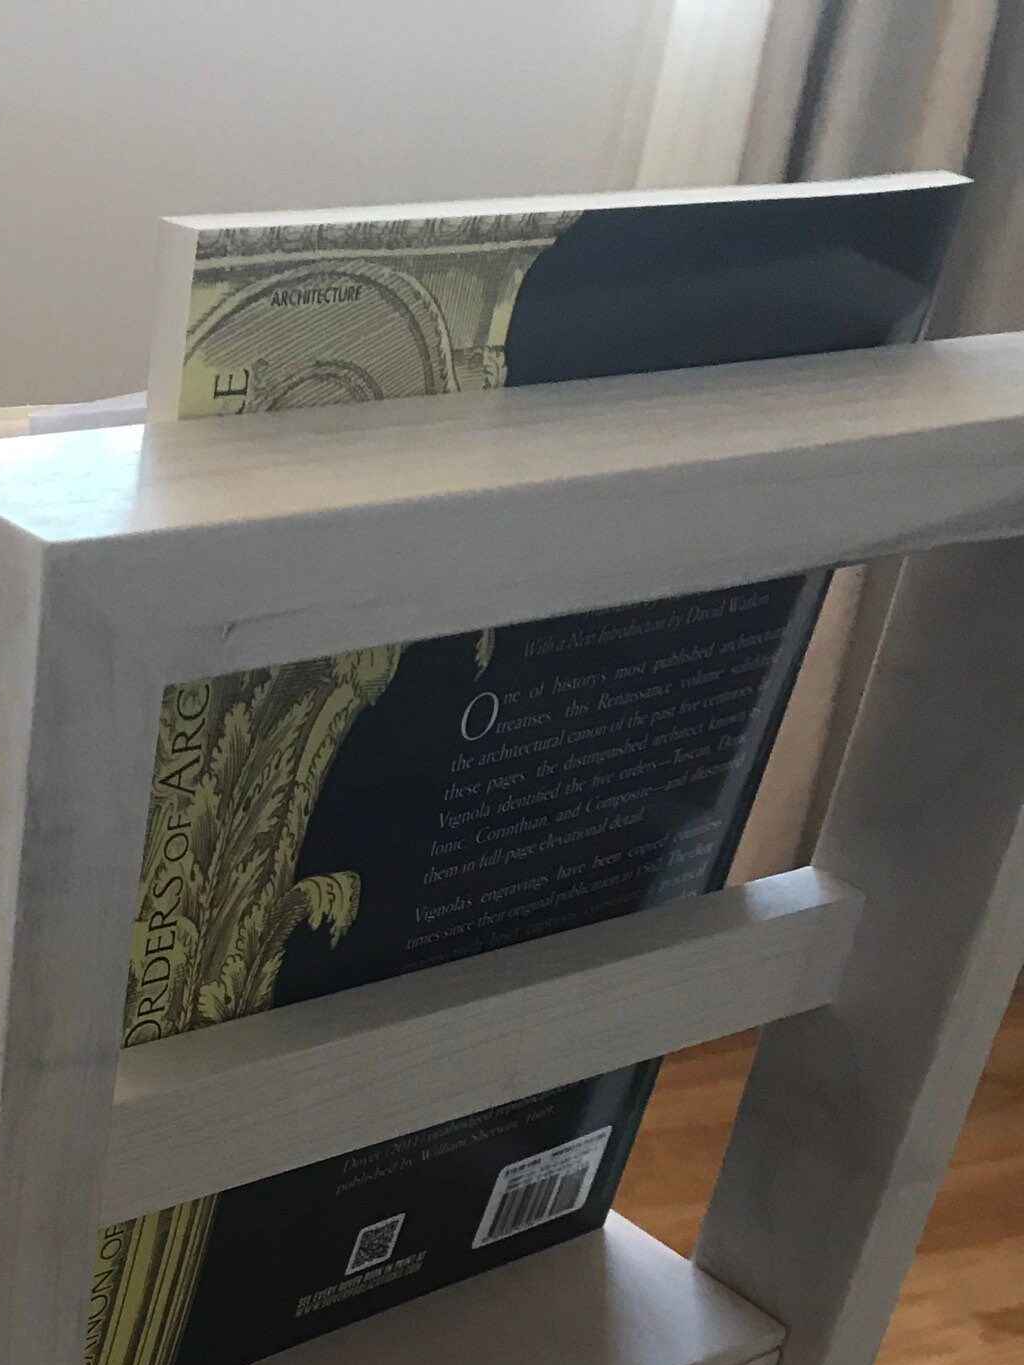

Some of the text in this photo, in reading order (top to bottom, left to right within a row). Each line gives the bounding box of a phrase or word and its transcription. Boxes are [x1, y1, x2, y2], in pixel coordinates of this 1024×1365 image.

[270, 284, 363, 308] ARCHITECTURE
[528, 680, 545, 700] of
[613, 661, 647, 681] most
[652, 640, 717, 675] published
[564, 699, 590, 719] this
[596, 682, 674, 711] Renaissance
[680, 670, 725, 690] volume
[444, 781, 482, 802] these
[536, 759, 560, 779] the
[562, 733, 650, 771] distinguished
[650, 722, 705, 748] architect
[451, 753, 475, 774] the
[477, 729, 566, 767] architectural
[567, 724, 608, 744] canon
[609, 716, 626, 734] of
[627, 710, 649, 728] the
[650, 705, 677, 727] past
[678, 696, 702, 715] five
[438, 800, 492, 830] Vignola
[496, 781, 563, 814] identified
[565, 776, 588, 796] the
[591, 769, 616, 789] five
[555, 800, 583, 823] and
[163, 810, 193, 863] OF
[422, 864, 459, 886] them
[461, 857, 476, 874] in
[478, 841, 538, 871] full-page
[414, 893, 473, 923] Vignola's
[479, 874, 550, 905] engravings
[555, 862, 587, 881] have
[591, 850, 622, 870] been
[405, 930, 441, 951] times
[441, 919, 476, 939] since
[476, 910, 508, 929] their
[507, 889, 556, 919] original
[334, 1161, 399, 1197] published
[420, 1137, 468, 1163] William
[100, 1224, 125, 1261] OF
